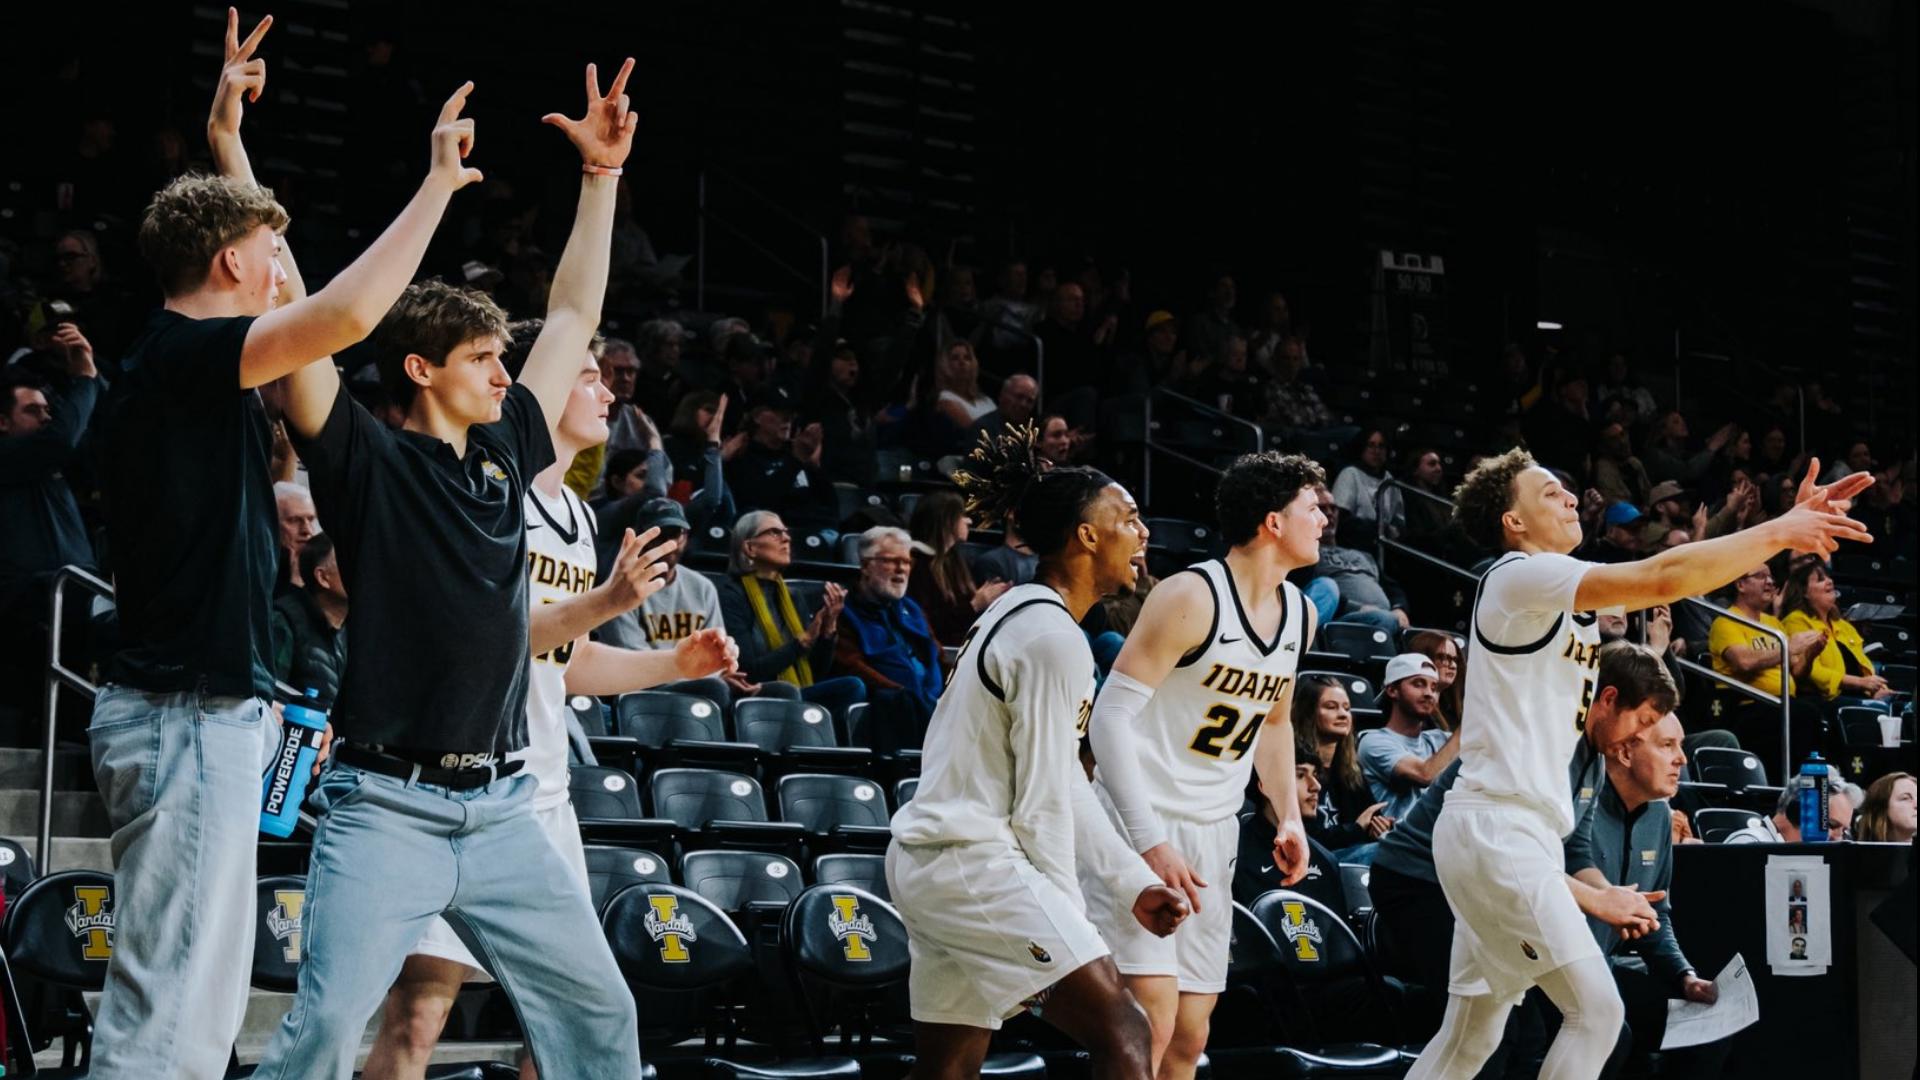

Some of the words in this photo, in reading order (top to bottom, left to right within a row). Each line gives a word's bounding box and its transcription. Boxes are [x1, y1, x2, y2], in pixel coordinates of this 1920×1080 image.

[1189, 703, 1267, 761] 24
[266, 727, 304, 815] POWERADE
[643, 911, 697, 942] Vandals
[828, 909, 878, 942] Vandals
